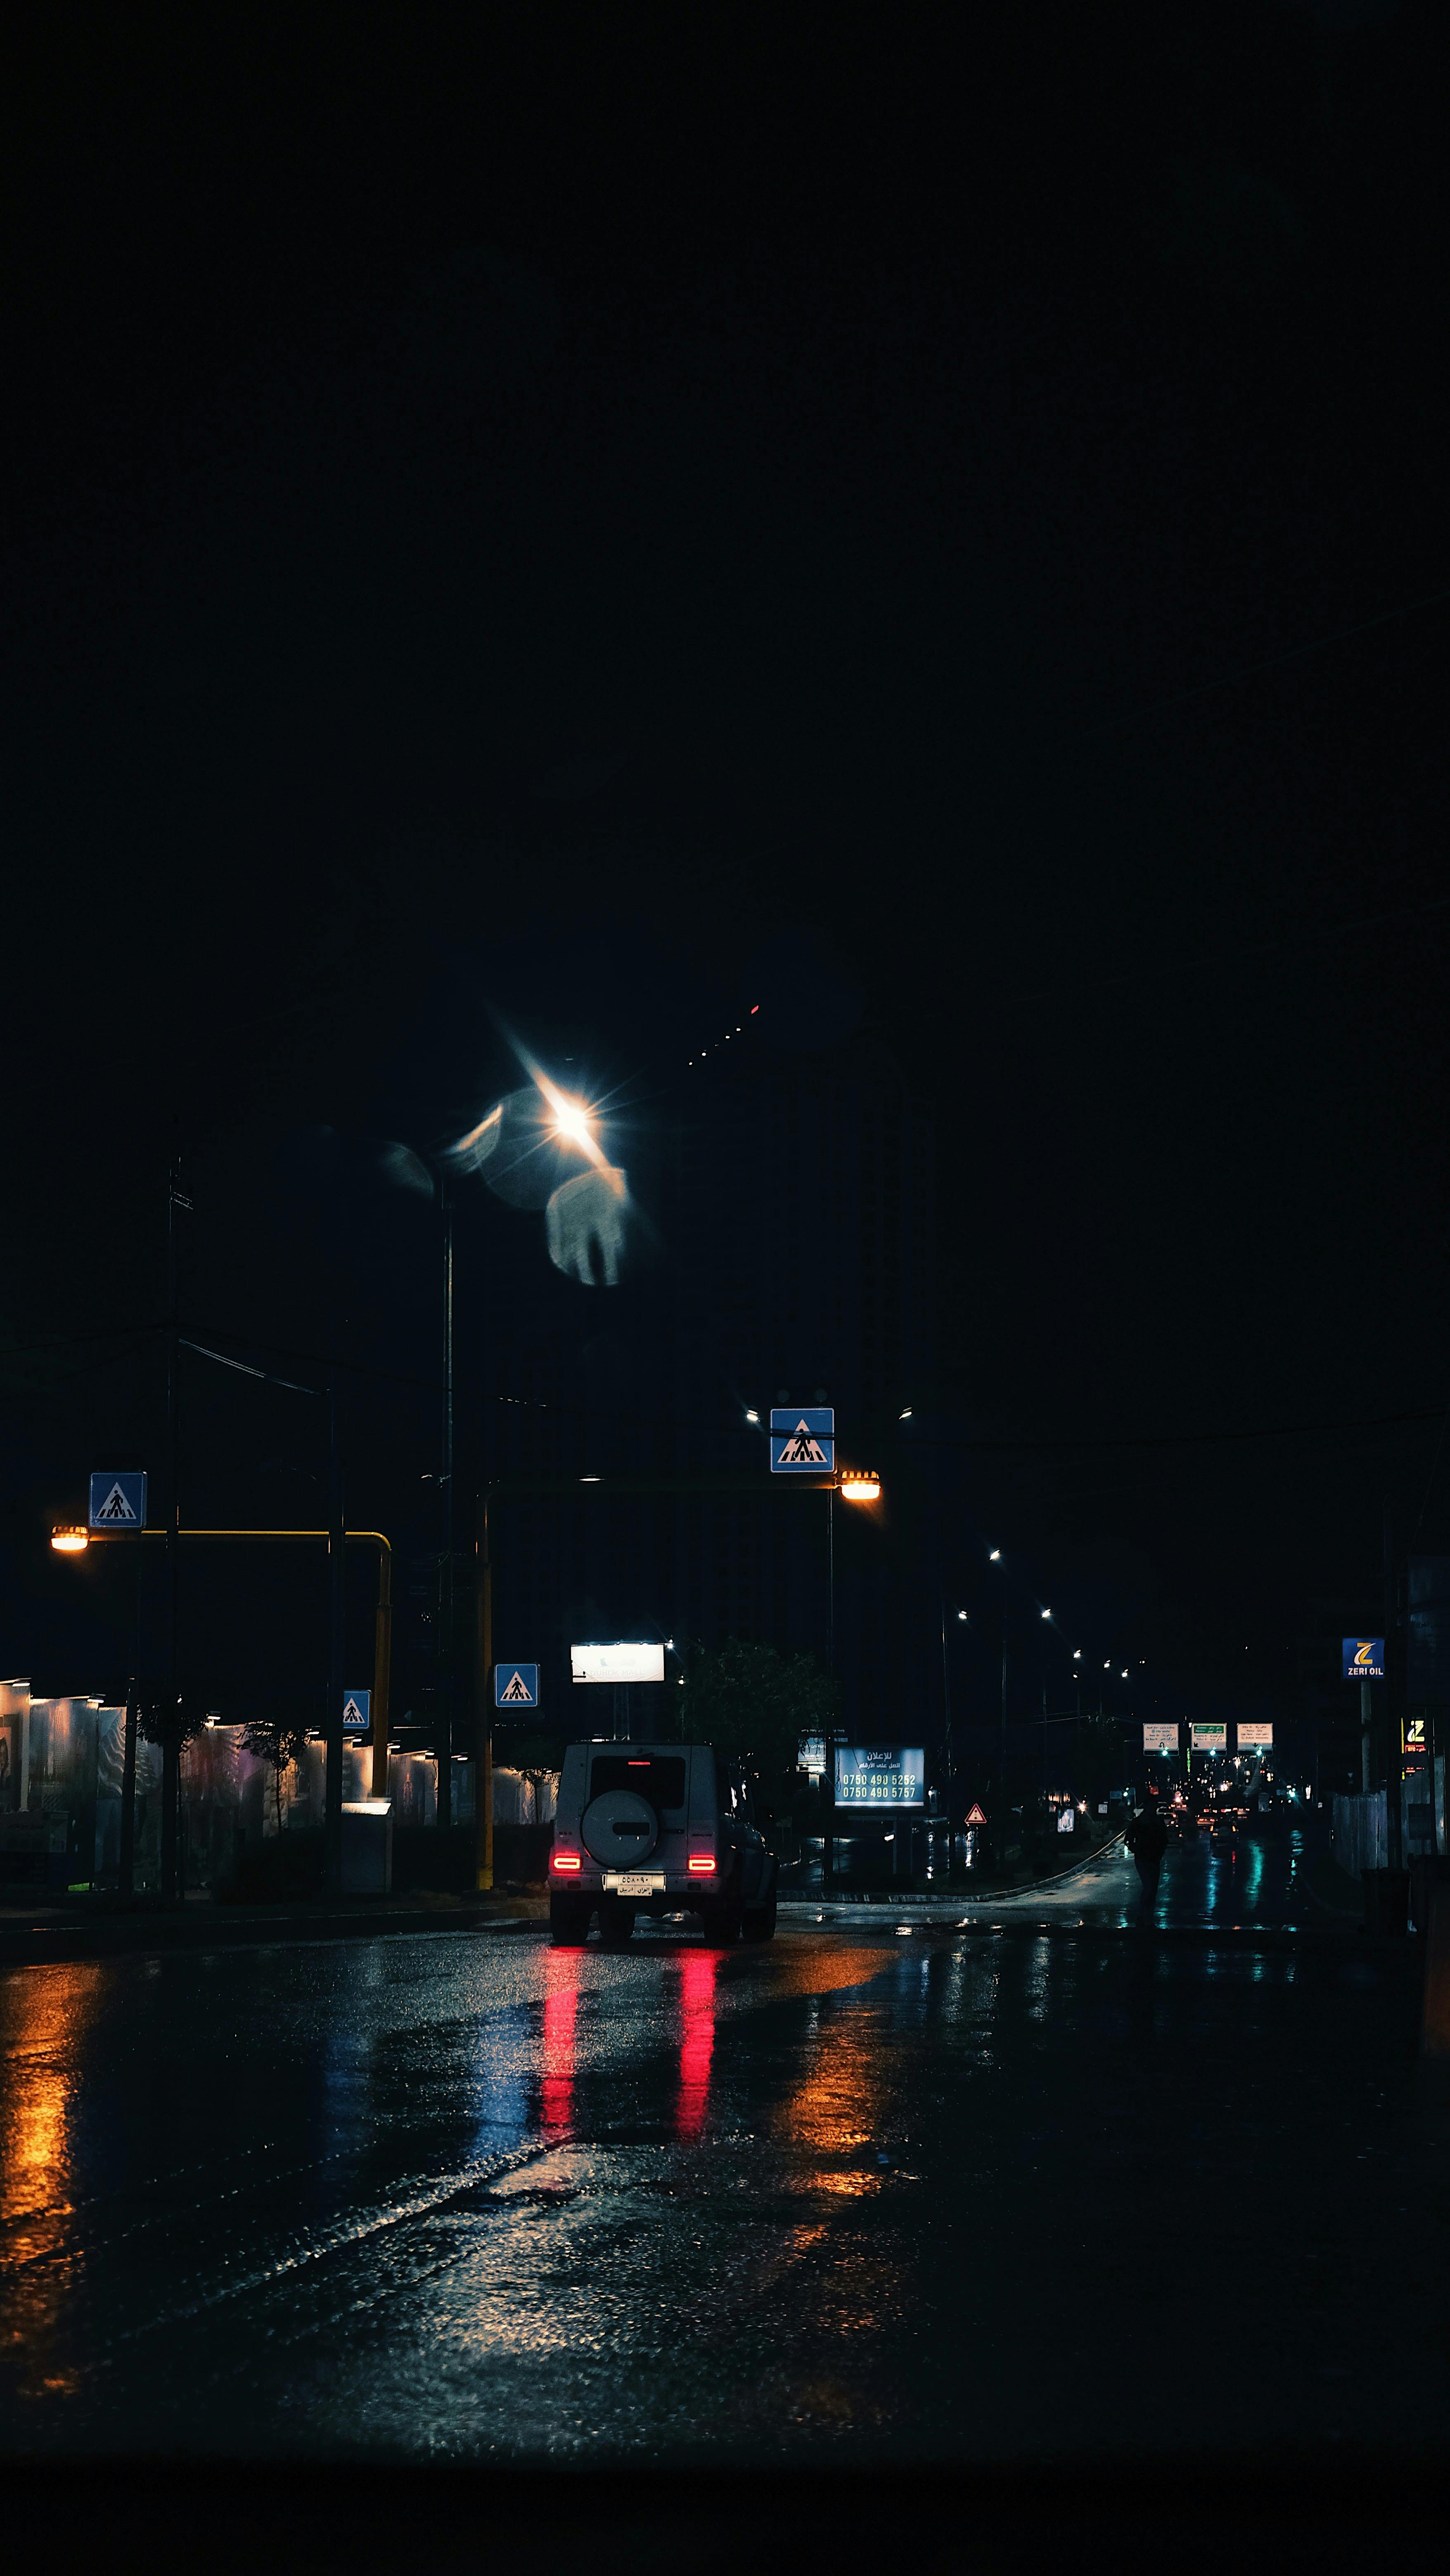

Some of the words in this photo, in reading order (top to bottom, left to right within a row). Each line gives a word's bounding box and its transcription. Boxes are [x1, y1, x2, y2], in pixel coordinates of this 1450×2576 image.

[867, 1752, 892, 1762] للإعلان
[843, 1774, 867, 1785] 0750
[870, 1774, 888, 1785] 490
[892, 1774, 915, 1785] 5252
[843, 1787, 867, 1798] 0750
[870, 1787, 888, 1798] 490
[892, 1787, 915, 1798] 5757
